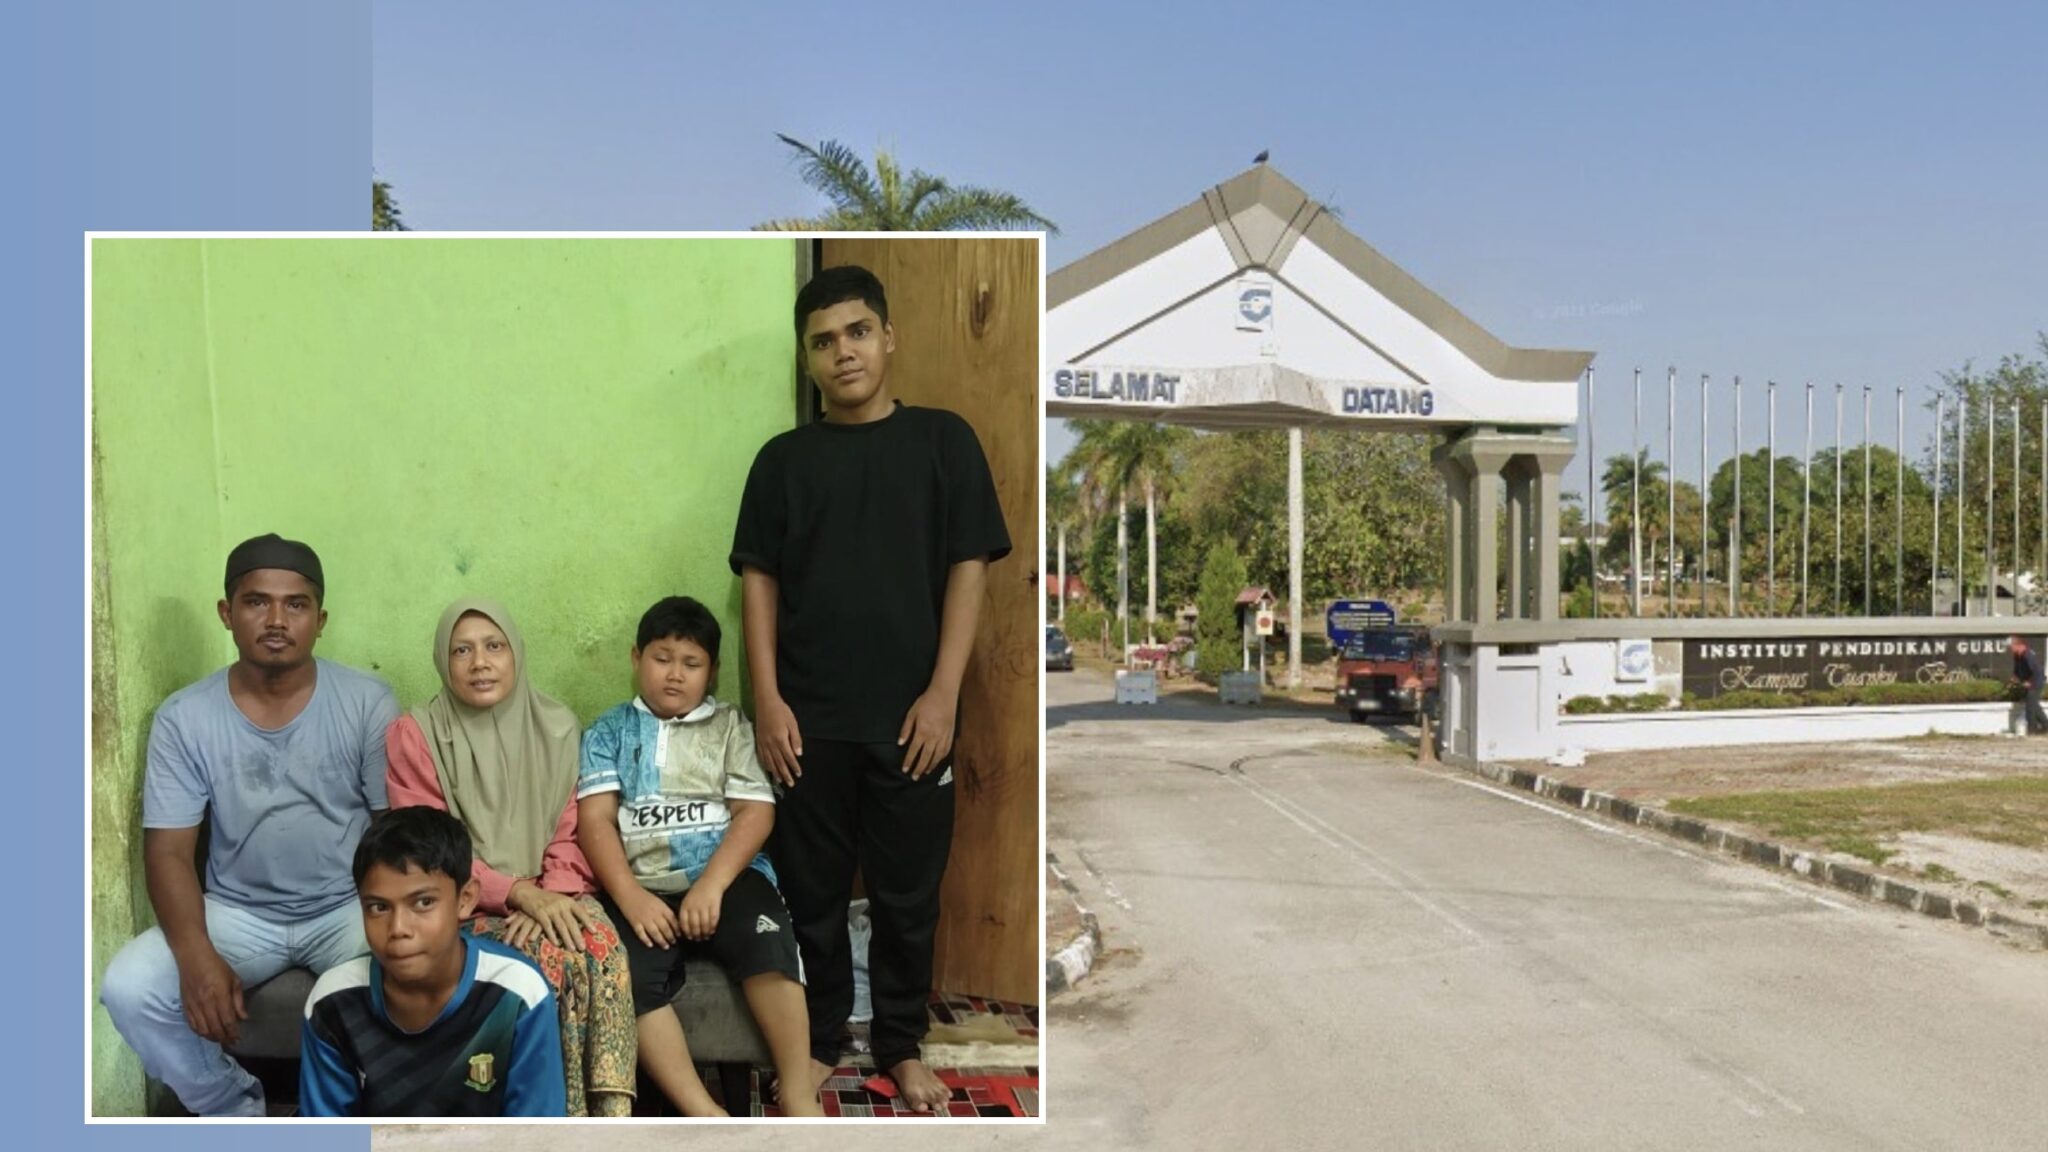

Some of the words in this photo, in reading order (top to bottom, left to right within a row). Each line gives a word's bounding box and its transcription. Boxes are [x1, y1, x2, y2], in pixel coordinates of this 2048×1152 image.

[1054, 369, 1180, 403] SELAMAT
[1342, 387, 1433, 416] DATANG
[1700, 643, 1807, 659] INSTITUT
[1819, 641, 1947, 657] PENDIDIKAN
[1719, 665, 1809, 695] Kampus
